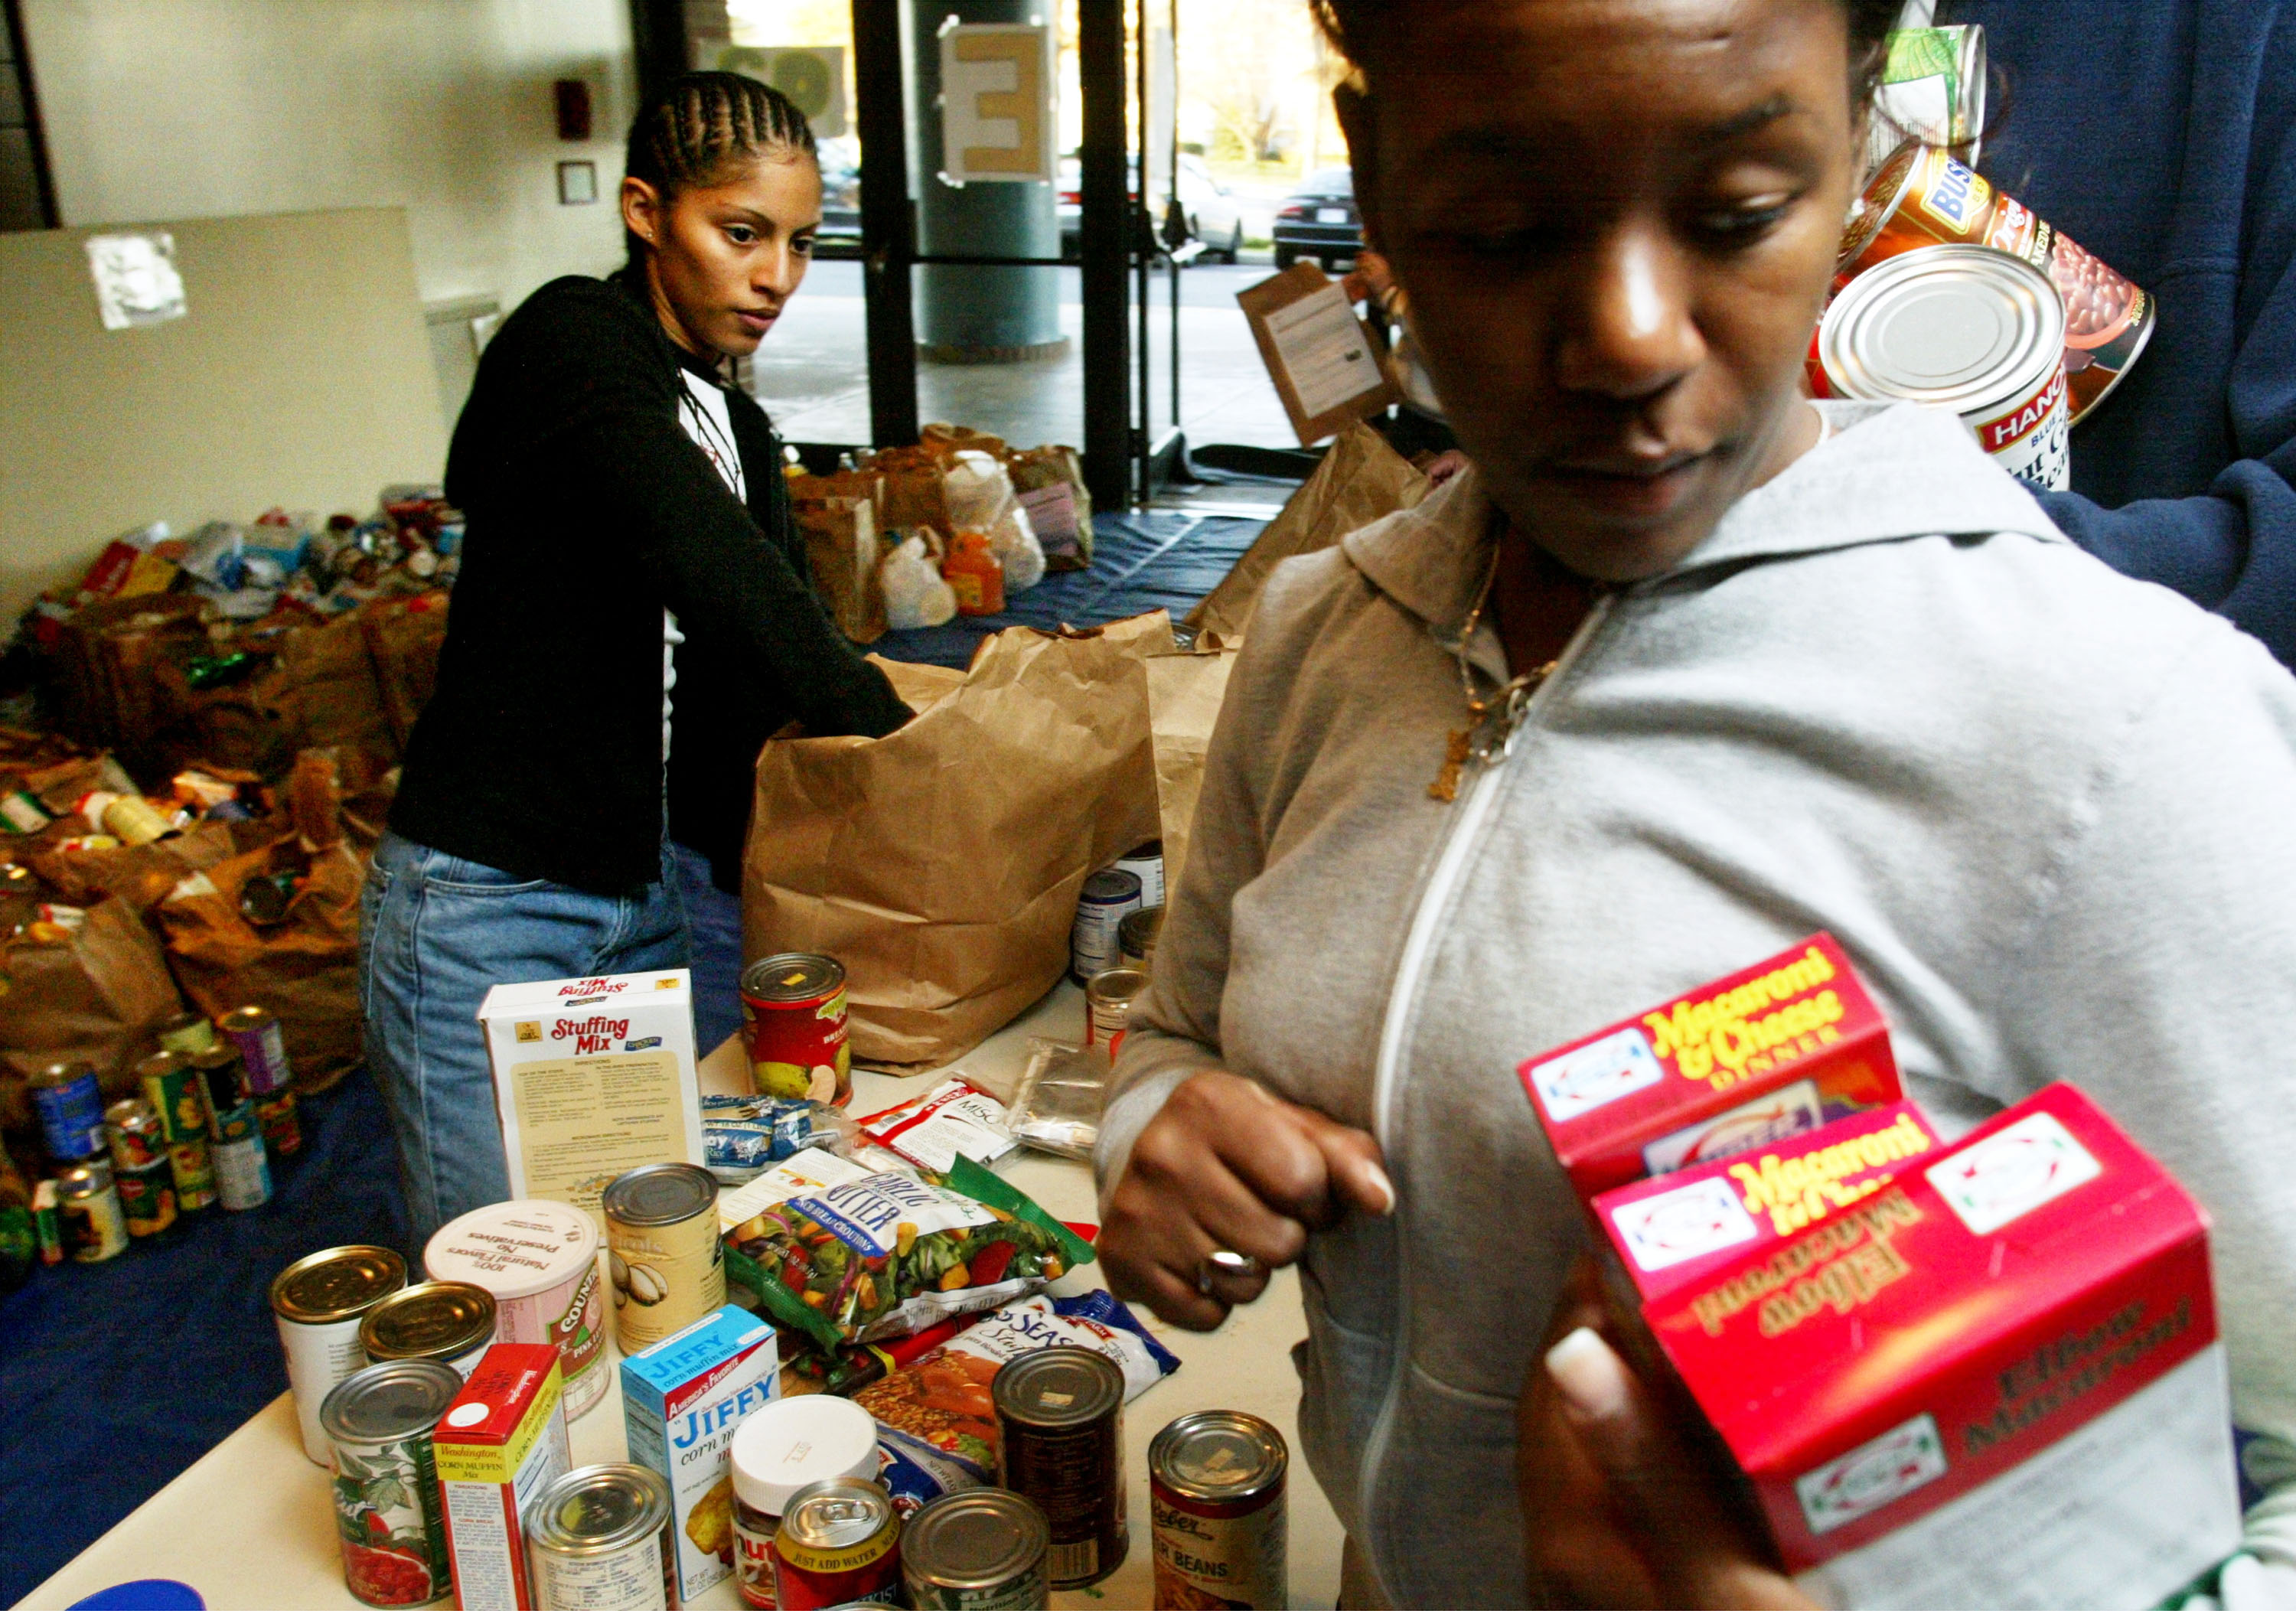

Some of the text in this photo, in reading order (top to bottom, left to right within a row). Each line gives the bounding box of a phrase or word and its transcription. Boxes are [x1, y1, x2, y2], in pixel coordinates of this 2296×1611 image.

[1994, 361, 2066, 445] HANO
[1642, 945, 1835, 1058] Macaroni
[550, 1016, 630, 1040] Stuffing
[1708, 989, 1844, 1071] Cheese
[575, 1034, 612, 1055] Mix
[1708, 1025, 1839, 1092] DINNER
[1727, 1112, 1931, 1215] Macaroni
[859, 1172, 940, 1208] GARLIC
[467, 1231, 560, 1254] Preservatives
[497, 1244, 517, 1254] No
[446, 1247, 550, 1271] Natural Flavors
[472, 1260, 507, 1272] 100%
[664, 1344, 740, 1388] corn muffin mix
[441, 1445, 497, 1460] Washington
[680, 1438, 718, 1466] corn
[437, 1460, 503, 1471] CORN MUFFIN
[792, 1553, 815, 1567] JUST
[818, 1558, 842, 1570] ADD
[843, 1547, 878, 1568] WATER
[1174, 1551, 1228, 1577] BEANS
